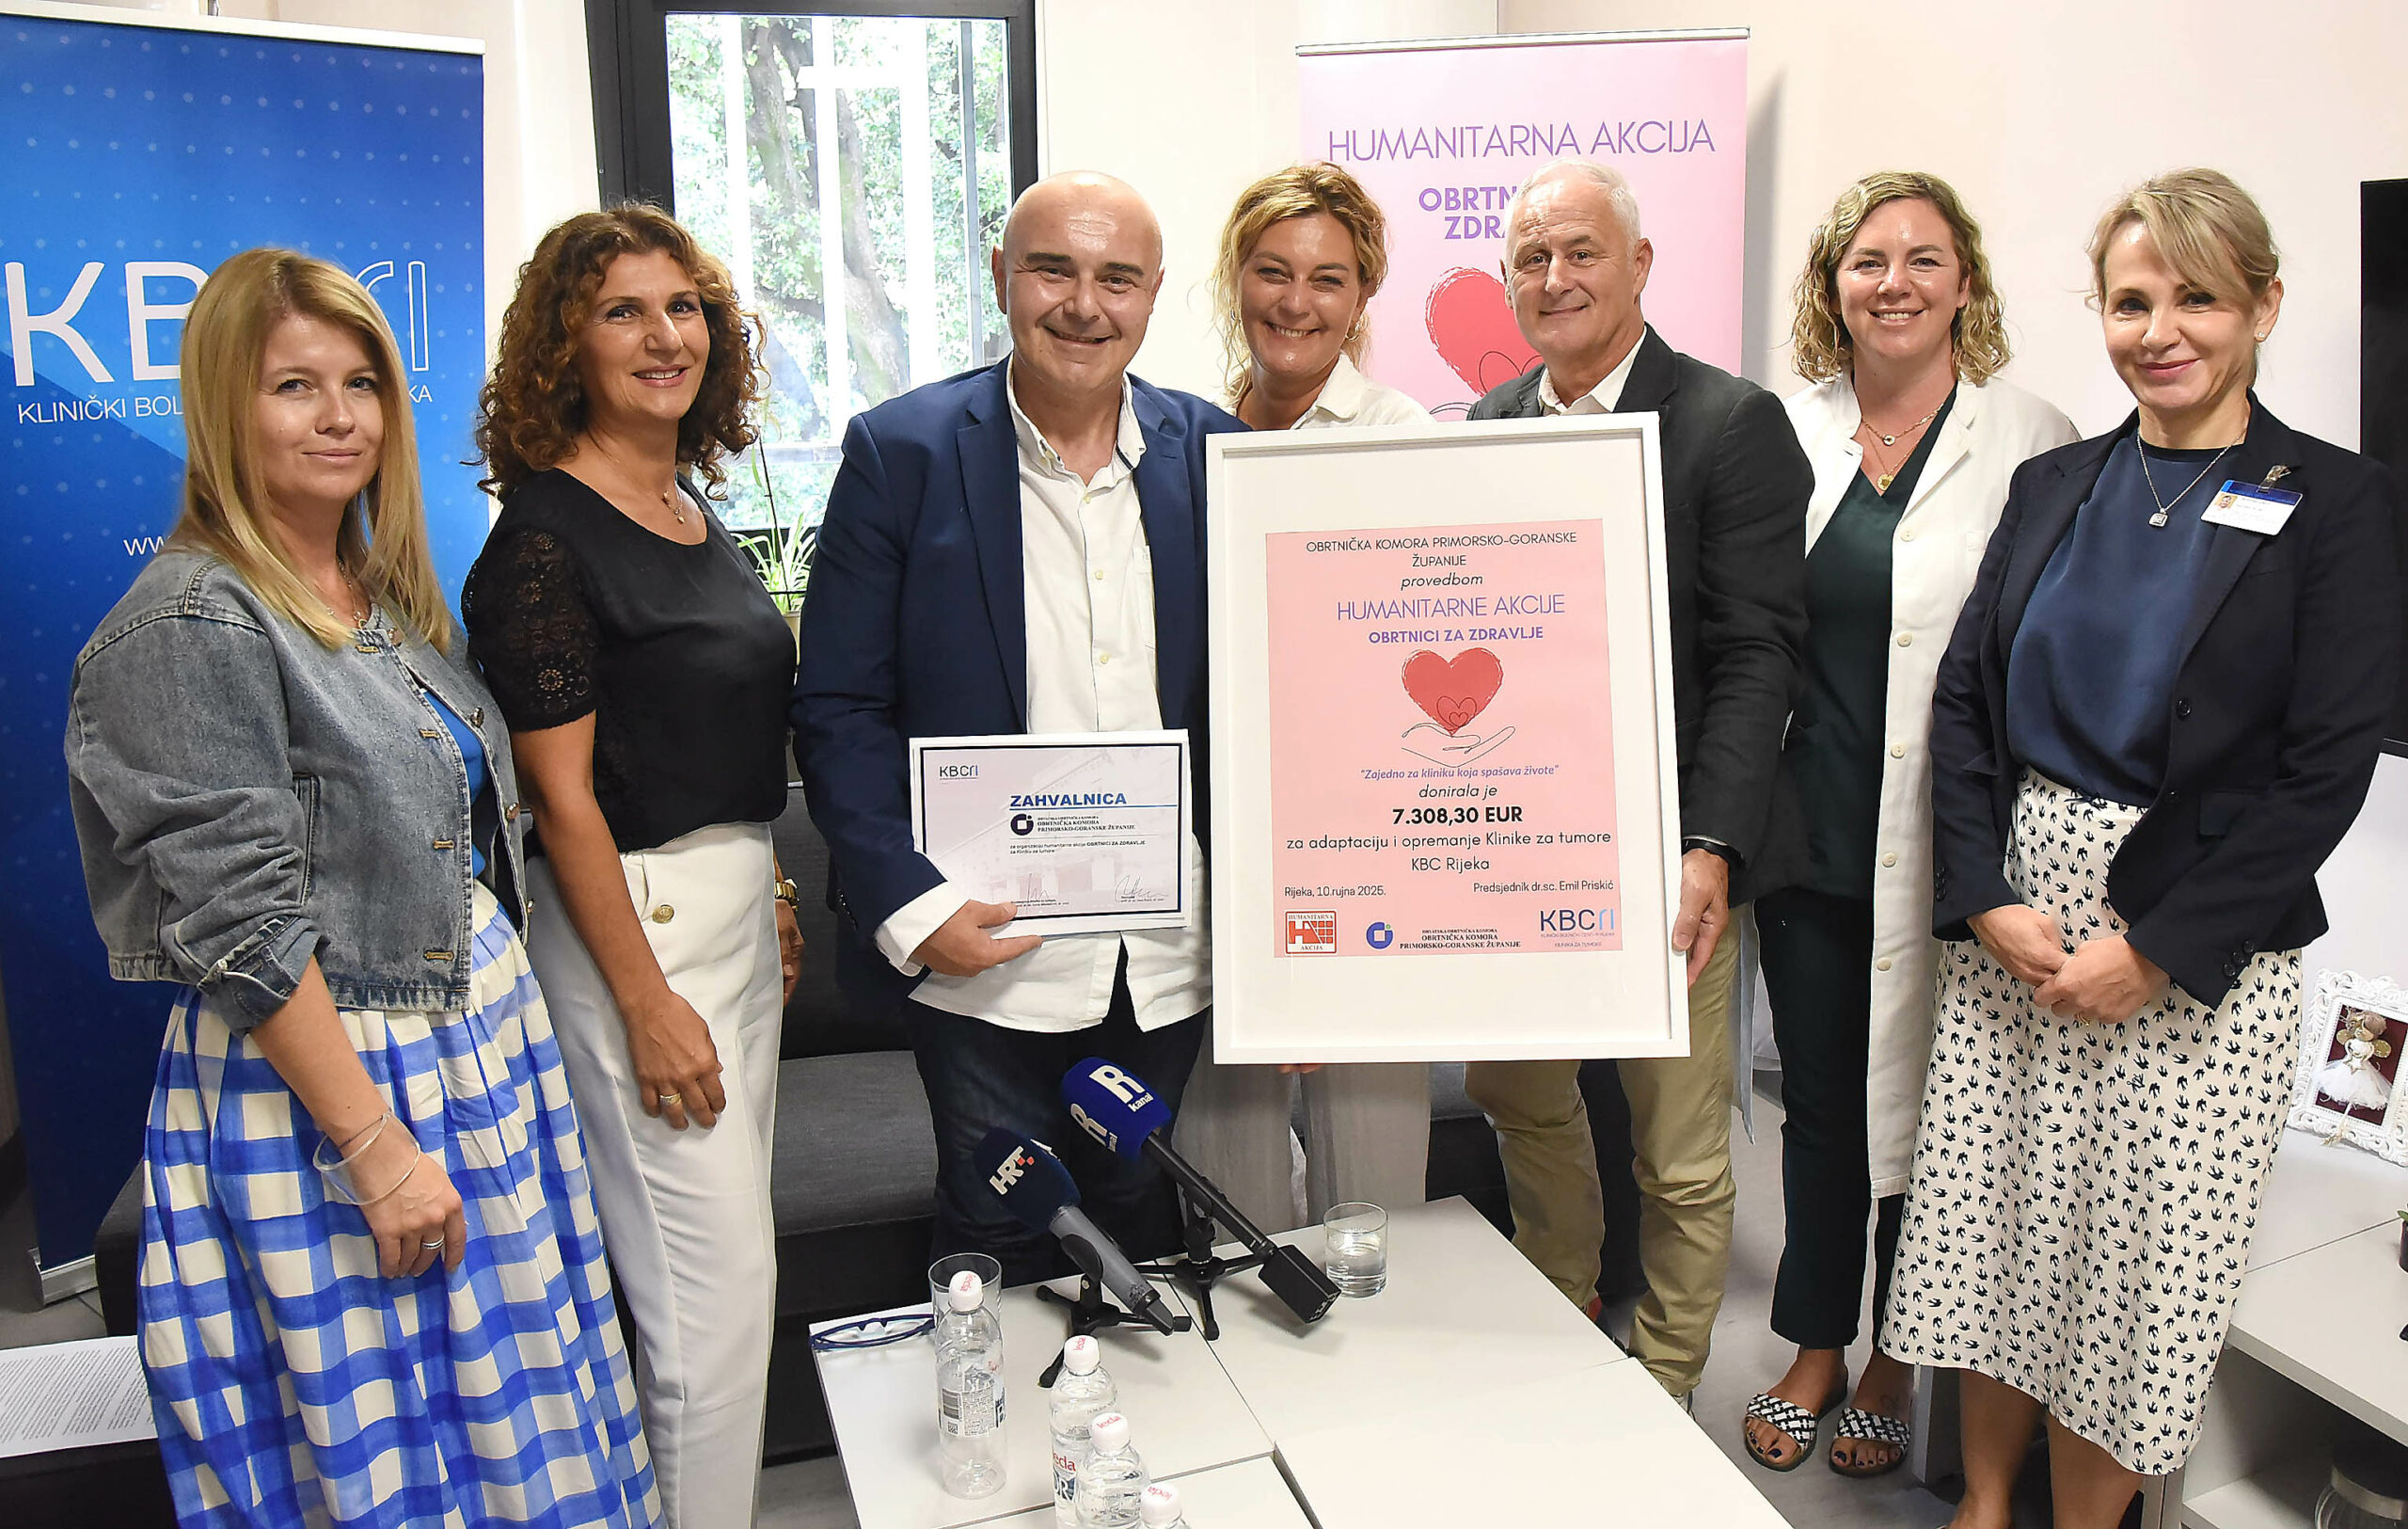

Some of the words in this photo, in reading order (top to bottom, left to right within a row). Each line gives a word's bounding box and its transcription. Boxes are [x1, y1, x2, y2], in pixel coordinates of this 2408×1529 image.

[1328, 122, 1581, 162] HUMANITARNA
[1590, 118, 1716, 154] AKCIJA
[1418, 185, 1517, 212] OBRTN
[1444, 215, 1505, 239] ZDR
[17, 393, 126, 424] KLINIČKI
[1306, 536, 1372, 552] OBRTNIČKA
[1375, 536, 1429, 550] KOMORA
[1433, 532, 1577, 549] PRIMORSKO-GORANSKE
[1412, 553, 1466, 567] ŽUPANIJE
[1401, 573, 1483, 591] provedbom
[1337, 597, 1486, 621] HUMANITARNE
[1494, 594, 1565, 615] AKCIJE
[1368, 629, 1439, 644] OBRTNICI
[1444, 629, 1465, 642] ZA
[1468, 627, 1544, 642] ZDRAVLJE
[1407, 770, 1419, 778] za
[1421, 766, 1455, 778] kliniku
[1457, 766, 1479, 779] koja
[1481, 765, 1522, 779] spašava
[1010, 792, 1127, 807] ZAHVALNICA
[1418, 784, 1480, 799] donirala
[1481, 785, 1498, 801] je
[1392, 806, 1479, 826] 7.308,30
[1485, 806, 1524, 823] EUR
[1287, 838, 1304, 850] za
[1308, 834, 1389, 852] adaptaciju
[1392, 835, 1397, 848] i
[1402, 834, 1481, 851] opremanje
[1485, 831, 1531, 846] Klinike
[1536, 834, 1553, 844] za
[1558, 831, 1611, 844] tumore
[1411, 857, 1442, 871] KBC
[1447, 856, 1490, 873] Rijeka
[1284, 885, 1315, 899] Rijeka,
[1317, 885, 1356, 899] 10.rujna
[1357, 884, 1386, 897] 2025.
[1473, 881, 1529, 895] Predsjednik
[1531, 881, 1558, 892] dr.sc.
[1559, 880, 1579, 891] Emil
[1581, 879, 1614, 891] Priskić
[1421, 933, 1464, 942] OBRTNIČKA
[1486, 940, 1521, 948] ŽUPANIJE
[1088, 1064, 1146, 1105] R
[1127, 1091, 1154, 1113] kanal
[1052, 1452, 1077, 1472] eda
